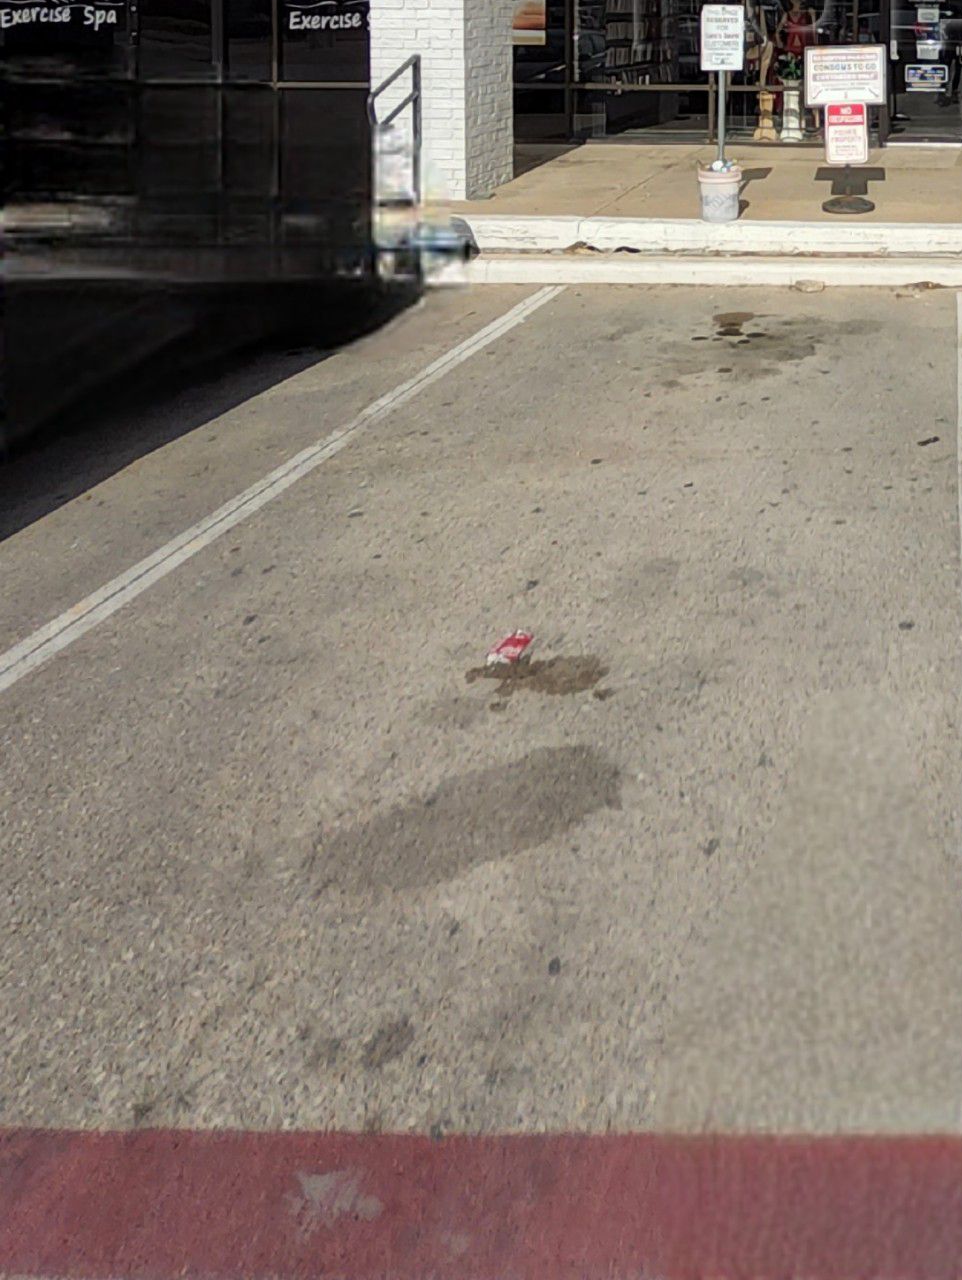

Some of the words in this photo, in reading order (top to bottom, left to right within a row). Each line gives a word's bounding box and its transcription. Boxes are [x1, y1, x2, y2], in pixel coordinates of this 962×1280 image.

[0, 7, 71, 28] Exercise
[83, 6, 117, 31] Spa
[289, 11, 362, 30] Exercise
